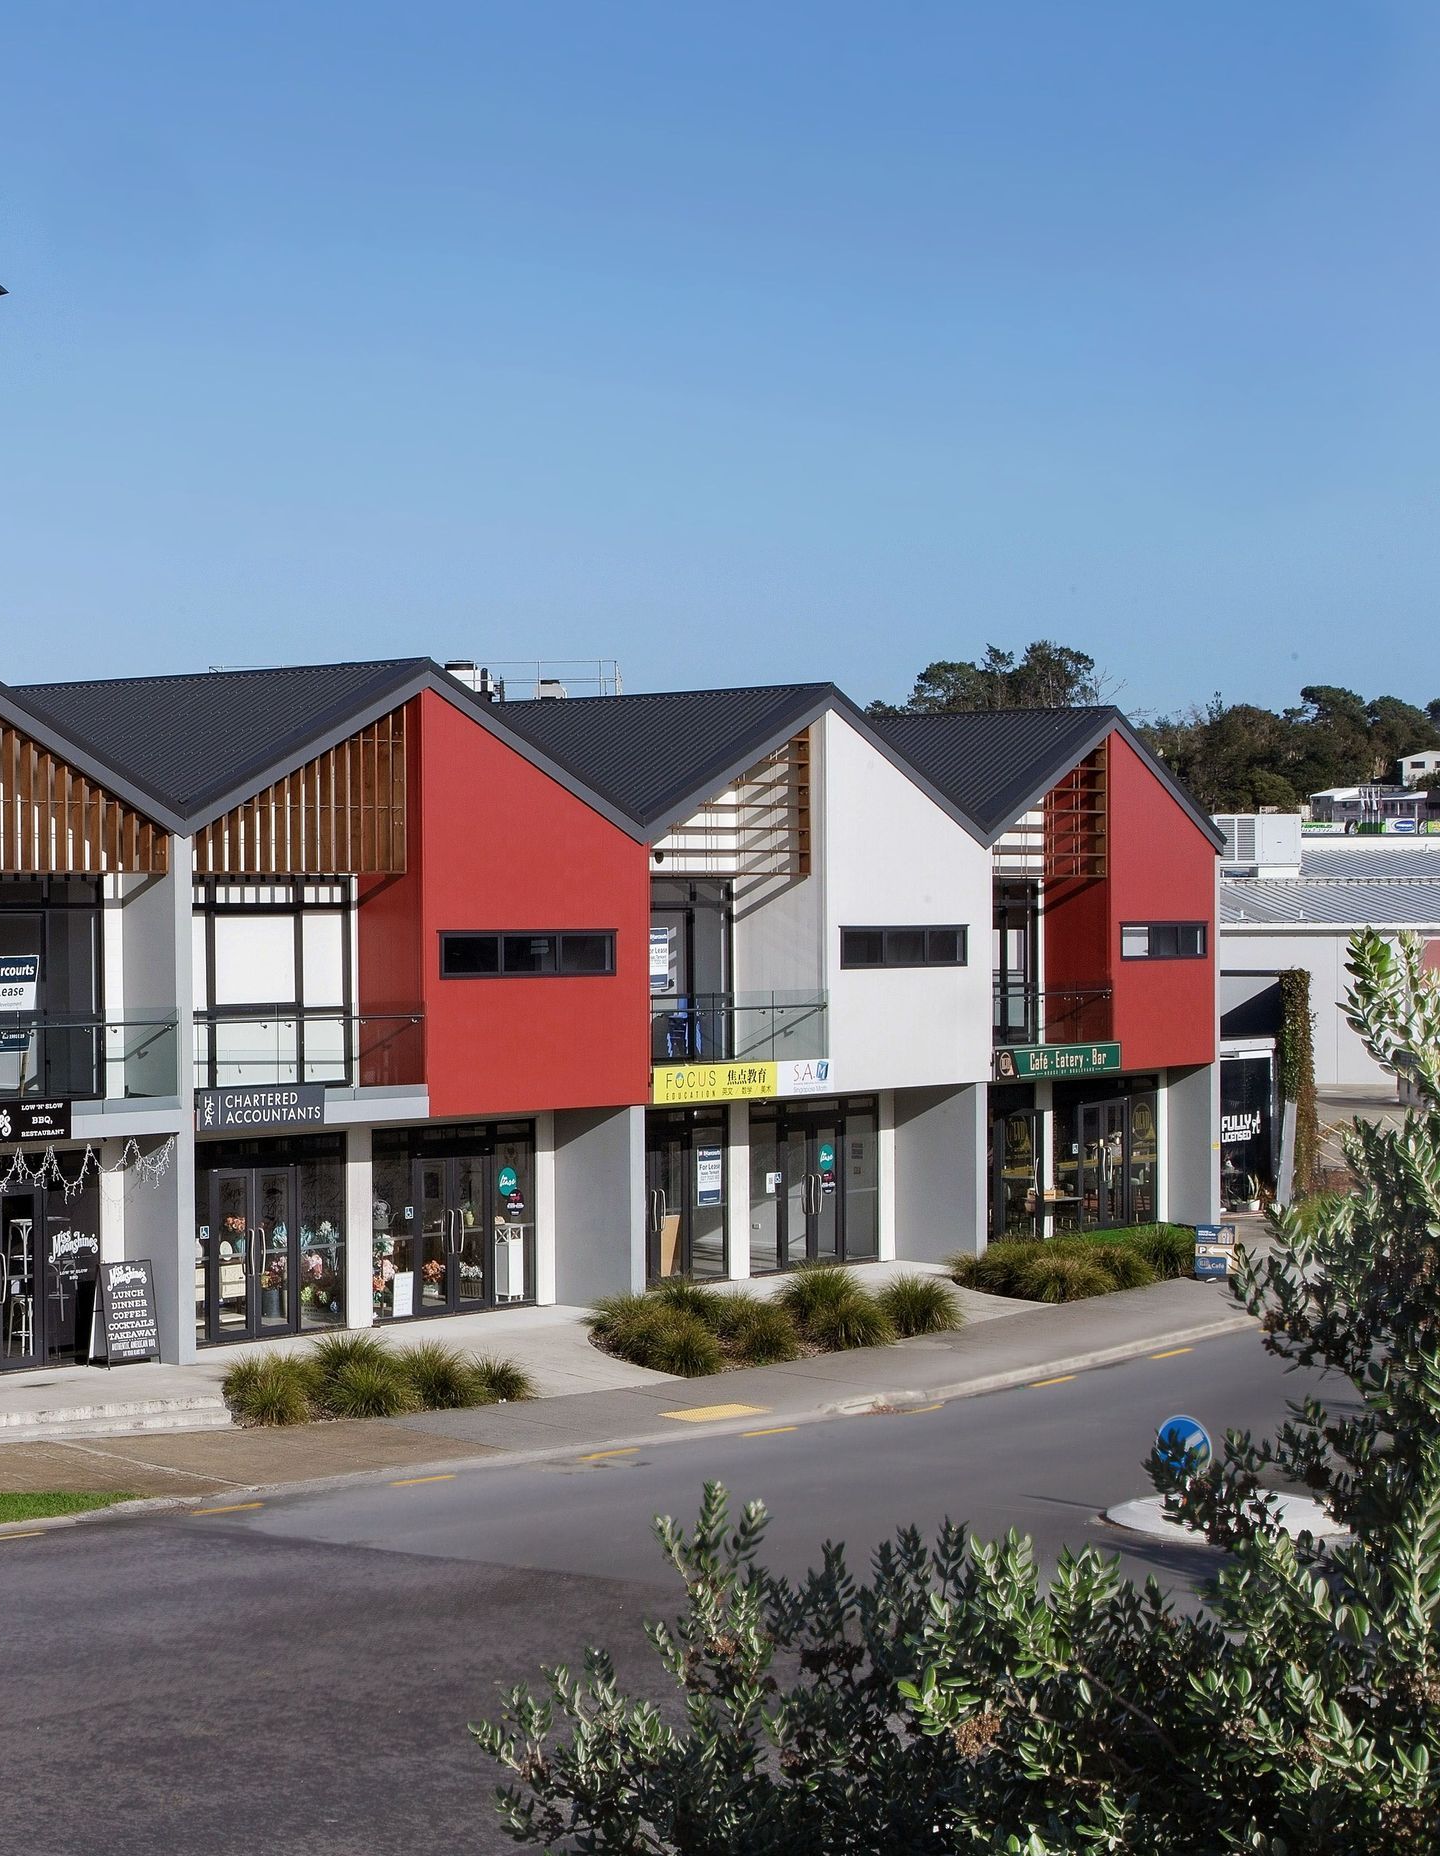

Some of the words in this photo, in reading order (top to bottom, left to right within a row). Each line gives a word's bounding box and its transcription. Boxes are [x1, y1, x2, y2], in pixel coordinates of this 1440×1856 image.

[1030, 1052, 1048, 1071] Café
[1055, 1051, 1084, 1068] Eatery
[1092, 1048, 1107, 1065] Bar
[666, 1070, 717, 1089] FOCUS
[727, 1068, 767, 1085] 焦点教育
[225, 1092, 298, 1109] CHARTERED
[666, 1090, 716, 1101] EDUCATION
[225, 1106, 321, 1125] ACCOUNTANTS
[1221, 1113, 1252, 1132] FULLY
[21, 1129, 64, 1138] RESTAURANT
[1221, 1130, 1252, 1143] LICENSED
[48, 1231, 98, 1263] Moonshine's
[1199, 1246, 1207, 1254] P
[112, 1289, 145, 1299] LUNCH
[111, 1299, 148, 1310] DINNER
[112, 1309, 148, 1320] COFFEE
[108, 1319, 155, 1330] COCKTAILS
[108, 1328, 157, 1341] TAKEAWAY
